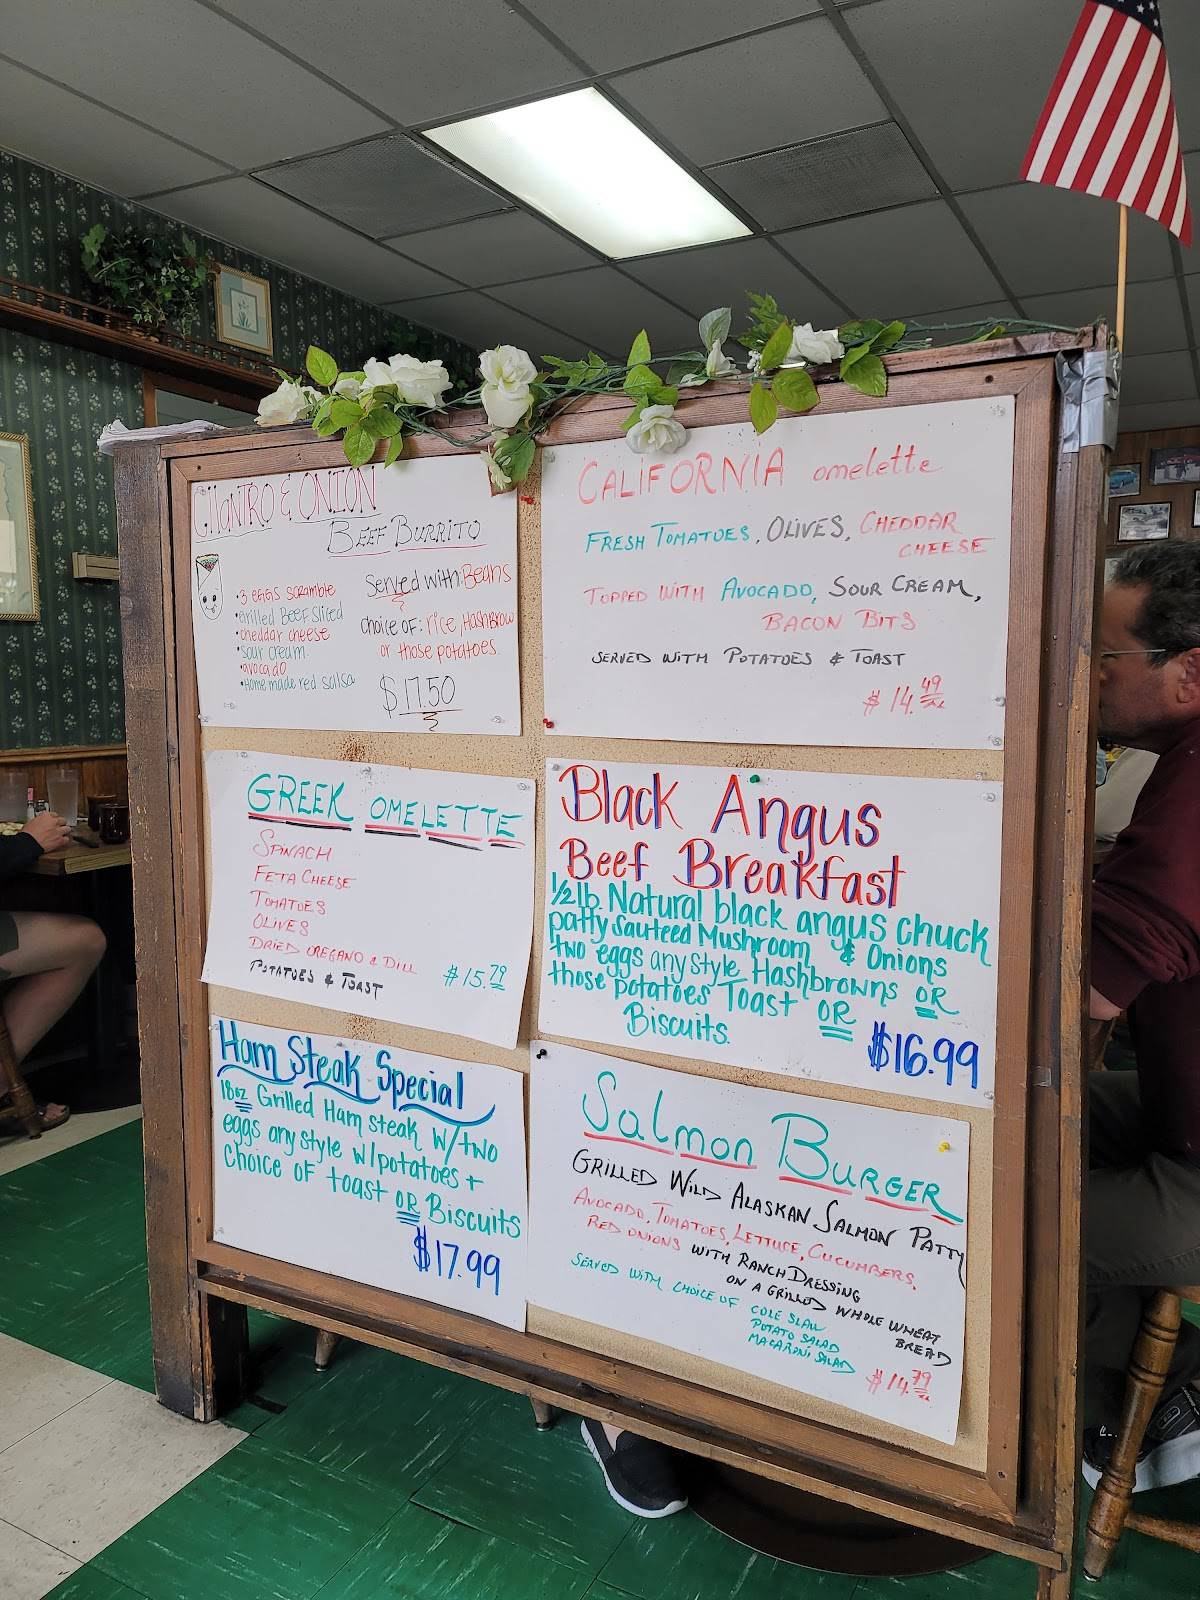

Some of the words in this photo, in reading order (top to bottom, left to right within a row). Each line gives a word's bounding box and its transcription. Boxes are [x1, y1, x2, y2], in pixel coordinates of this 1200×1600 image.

[299, 465, 377, 520] ONION
[578, 447, 785, 504] CALIFORNIA
[812, 444, 943, 483] omelette
[327, 520, 387, 554] BEEF
[391, 514, 481, 547] BURRITO
[585, 531, 645, 554] FRESH
[860, 511, 959, 535] CHEDDAR
[899, 537, 997, 558] CHEESE
[240, 589, 247, 605] 3
[365, 569, 420, 597] Served
[461, 563, 512, 590] Beans
[584, 587, 648, 606] TOPPED
[659, 581, 704, 601] WITH
[721, 576, 817, 605] AVOCADO,
[829, 575, 881, 598] SOUR
[891, 575, 981, 602] CREAM,
[240, 627, 282, 642] cheddar
[289, 627, 330, 642] cheese
[762, 611, 842, 632] BACON
[854, 608, 916, 630] BITS
[241, 645, 263, 659] sour
[380, 643, 391, 659] or
[398, 642, 432, 660] those
[591, 651, 651, 665] SERVED
[662, 651, 708, 665] WITH
[724, 646, 812, 666] POTATOES
[829, 652, 844, 667] &
[850, 648, 906, 667] TOAST
[299, 674, 317, 690] red
[321, 672, 355, 690] salsa
[247, 772, 354, 823] GREEK
[369, 796, 526, 838] OMELETTE
[558, 764, 684, 831] Black
[711, 773, 882, 865] Angus
[252, 828, 332, 862] SPINACH
[254, 864, 296, 884] FETA
[301, 868, 357, 890] CHEESE
[559, 837, 650, 882] Beef
[673, 837, 907, 908] Breakfast
[250, 889, 327, 916] TOMATOES
[608, 881, 702, 922] Natural
[714, 889, 788, 930] black
[796, 909, 888, 952] angus
[252, 912, 310, 937] OLIVES
[549, 905, 609, 944] patty
[699, 923, 811, 968] Mushroom
[839, 938, 856, 967] &
[867, 943, 948, 985] Onions
[248, 935, 300, 954] DRIED
[306, 944, 364, 964] OREGANO
[369, 955, 378, 967] &
[383, 955, 418, 976] DILL
[550, 934, 586, 960] two
[596, 944, 644, 979] eggs
[752, 956, 898, 1007] Hashbrowns
[915, 986, 960, 1015] OR
[249, 958, 315, 984] POTATOES
[324, 973, 334, 986] &
[341, 971, 384, 1000] TOAST
[547, 960, 606, 991] those
[614, 974, 711, 1006] potatoes
[717, 978, 798, 1017] Toast
[817, 999, 857, 1025] OR
[218, 1020, 285, 1080] Ham
[288, 1035, 361, 1094] Steak
[376, 1050, 465, 1110] Special
[868, 1020, 979, 1089] $16.99
[223, 1114, 260, 1146] eggs
[257, 1084, 314, 1118] Grilled
[324, 1099, 362, 1137] Ham
[369, 1114, 422, 1151] steak
[582, 1071, 754, 1167] Salmon
[326, 1166, 389, 1202] toast
[396, 1191, 420, 1214] OR
[425, 1193, 521, 1239] Biscuits
[572, 1148, 657, 1185] GRILLED
[670, 1169, 722, 1200] WILD
[731, 1181, 811, 1224] ALASKAN
[813, 1200, 902, 1246] SALMON
[909, 1226, 966, 1289] PATTY
[573, 1187, 650, 1224] AVOCADO,
[652, 1201, 729, 1245] TOMATOES,
[733, 1224, 804, 1261] LETTUCE,
[413, 1225, 500, 1296] $17.99
[587, 1214, 621, 1233] RED
[628, 1227, 680, 1251] ONIONS
[692, 1244, 731, 1265] WITH
[738, 1253, 787, 1279] RANCH
[788, 1265, 860, 1302] DRESSING
[571, 1252, 619, 1274] SERVED
[630, 1267, 663, 1291] WITH
[673, 1281, 716, 1301] CHOICE
[719, 1295, 740, 1308] OF
[751, 1305, 782, 1320] COLE
[787, 1313, 826, 1332] SLAW
[726, 1275, 747, 1287] ON
[752, 1283, 761, 1292] A
[836, 1305, 884, 1326] WHOLE
[889, 1320, 941, 1345] WHEAT
[748, 1334, 811, 1358] MACARONI
[815, 1352, 855, 1373] SALAD
[751, 1319, 795, 1340] POTATO
[801, 1334, 839, 1353] SALAD
[895, 1338, 952, 1366] BREAD
